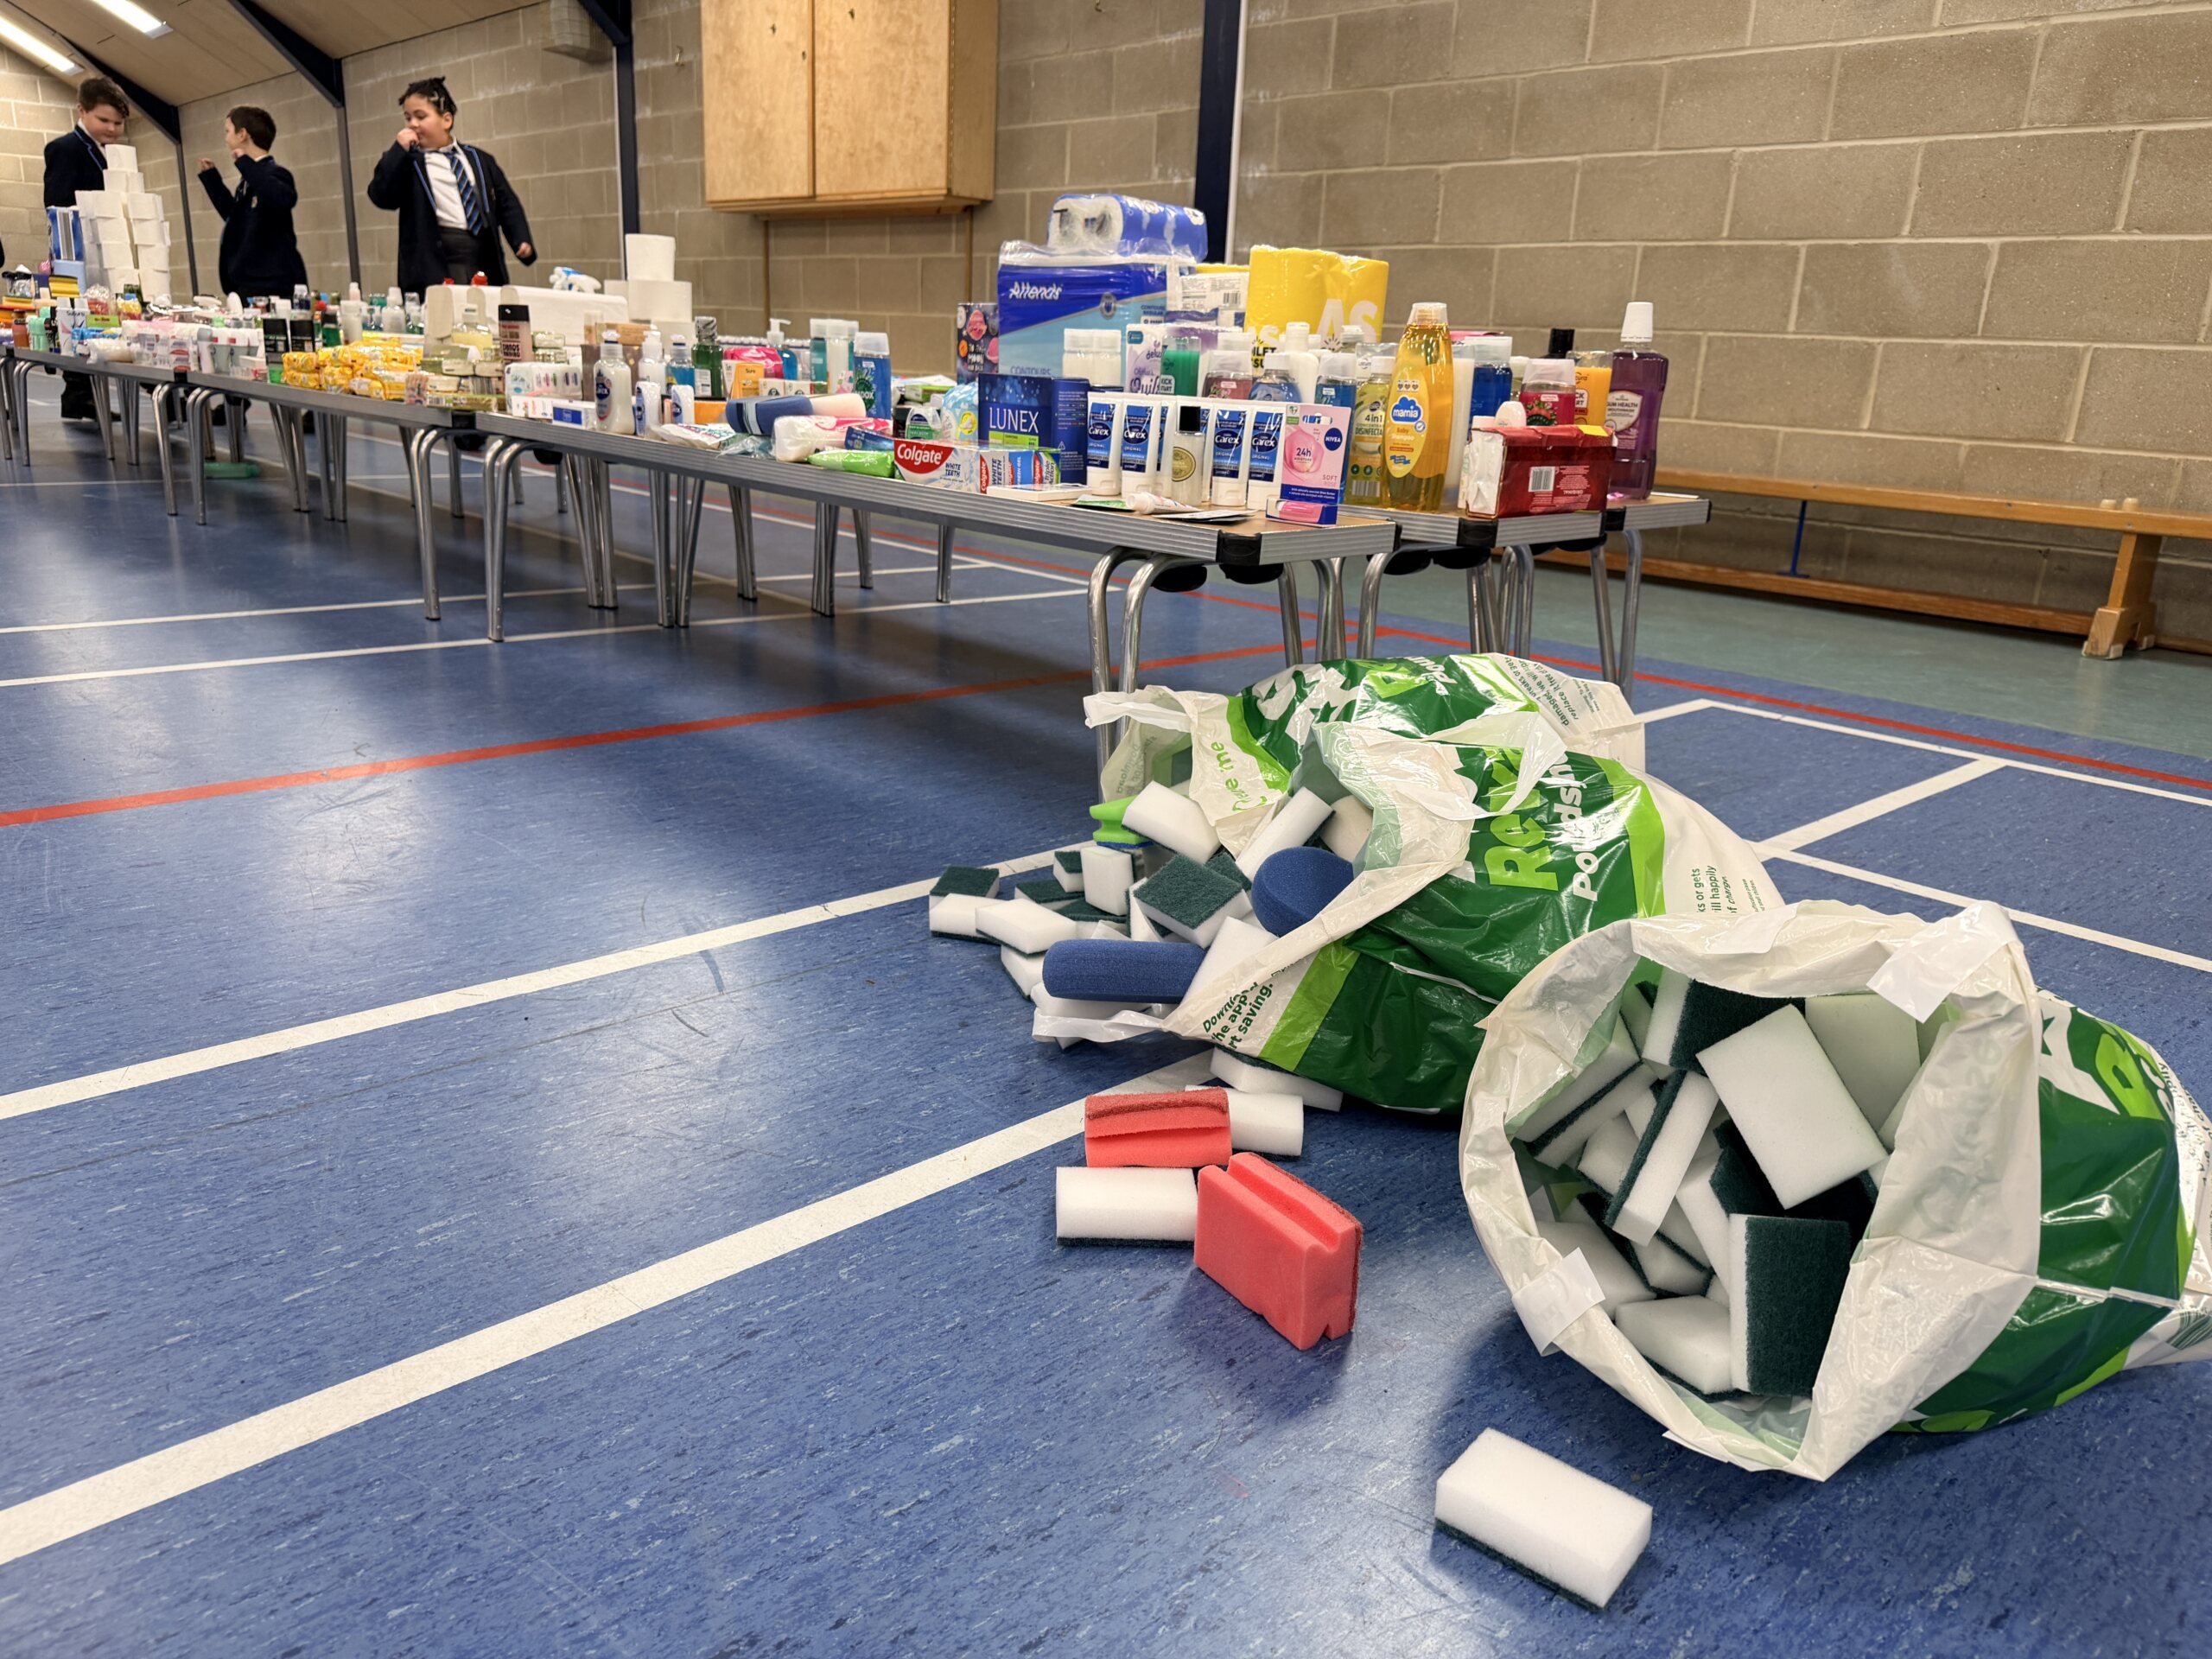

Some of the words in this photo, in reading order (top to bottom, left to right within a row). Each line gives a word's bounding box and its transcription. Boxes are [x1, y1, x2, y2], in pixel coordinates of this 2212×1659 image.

[1009, 281, 1062, 300] Attends
[1393, 406, 1418, 417] mamia
[989, 407, 1039, 434] LUNEX
[1089, 427, 1109, 435] Carex
[1124, 430, 1146, 439] Carex
[1215, 435, 1239, 444] Carex
[1252, 438, 1274, 447] Carex
[897, 443, 943, 466] Colgate
[1296, 448, 1312, 457] 24h
[945, 462, 961, 472] WHITE
[945, 469, 961, 478] TEETH
[1542, 690, 1570, 726] damaged,
[1559, 691, 1579, 720] replace
[1211, 741, 1234, 773] me
[1691, 868, 1705, 888] gets
[1706, 865, 1721, 899] happily
[1696, 891, 1705, 900] or
[1238, 983, 1273, 1034] saving.
